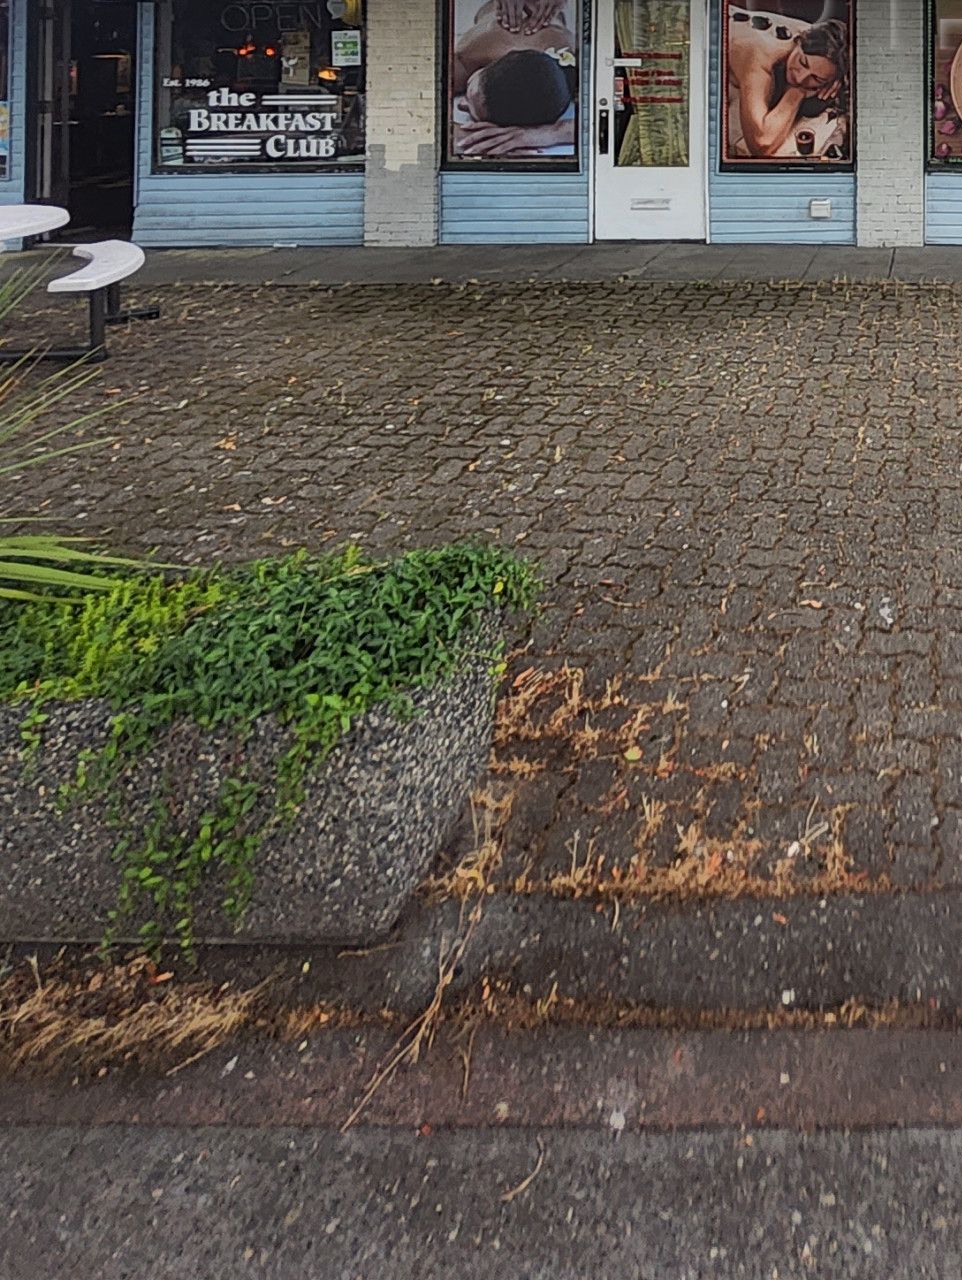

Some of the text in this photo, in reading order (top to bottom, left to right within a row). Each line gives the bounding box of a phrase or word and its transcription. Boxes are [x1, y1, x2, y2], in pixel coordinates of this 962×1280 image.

[221, 4, 322, 31] OPEN
[207, 87, 256, 106] the
[188, 108, 337, 132] BREAKFAST
[265, 134, 336, 158] CLUB
